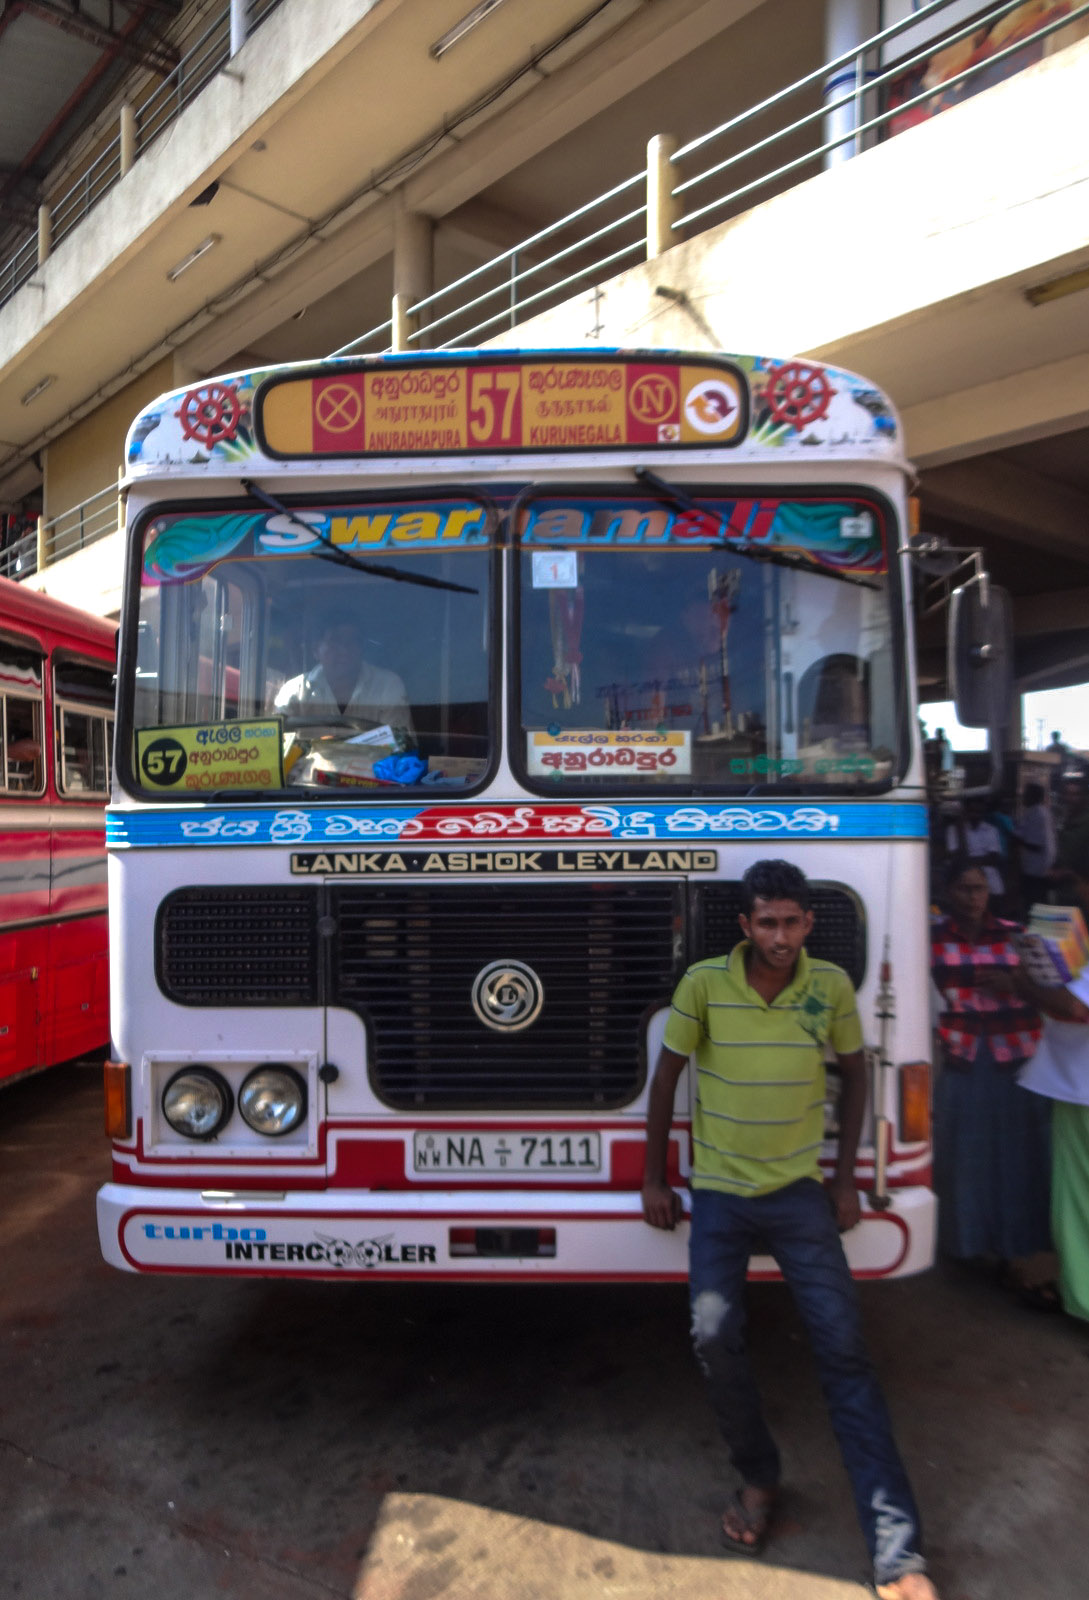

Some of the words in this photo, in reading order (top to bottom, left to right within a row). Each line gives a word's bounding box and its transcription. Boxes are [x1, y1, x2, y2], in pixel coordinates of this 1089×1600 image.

[371, 370, 460, 399] අනුරාධපුර
[470, 371, 521, 441] 57
[369, 430, 461, 450] ANURADHAPURA
[530, 424, 622, 444] KURUNEGALA
[147, 751, 183, 775] 57
[189, 746, 260, 765] අනුරාධපුර
[541, 748, 677, 771] අනුරාධපුර
[180, 815, 260, 837] ජය
[291, 853, 407, 873] LANKA
[422, 852, 543, 872] ASHOK
[557, 851, 716, 871] LEYLAND
[418, 1151, 441, 1166] NW
[447, 1136, 485, 1167] NA
[521, 1136, 596, 1167] 7111
[142, 1223, 267, 1242] turbo
